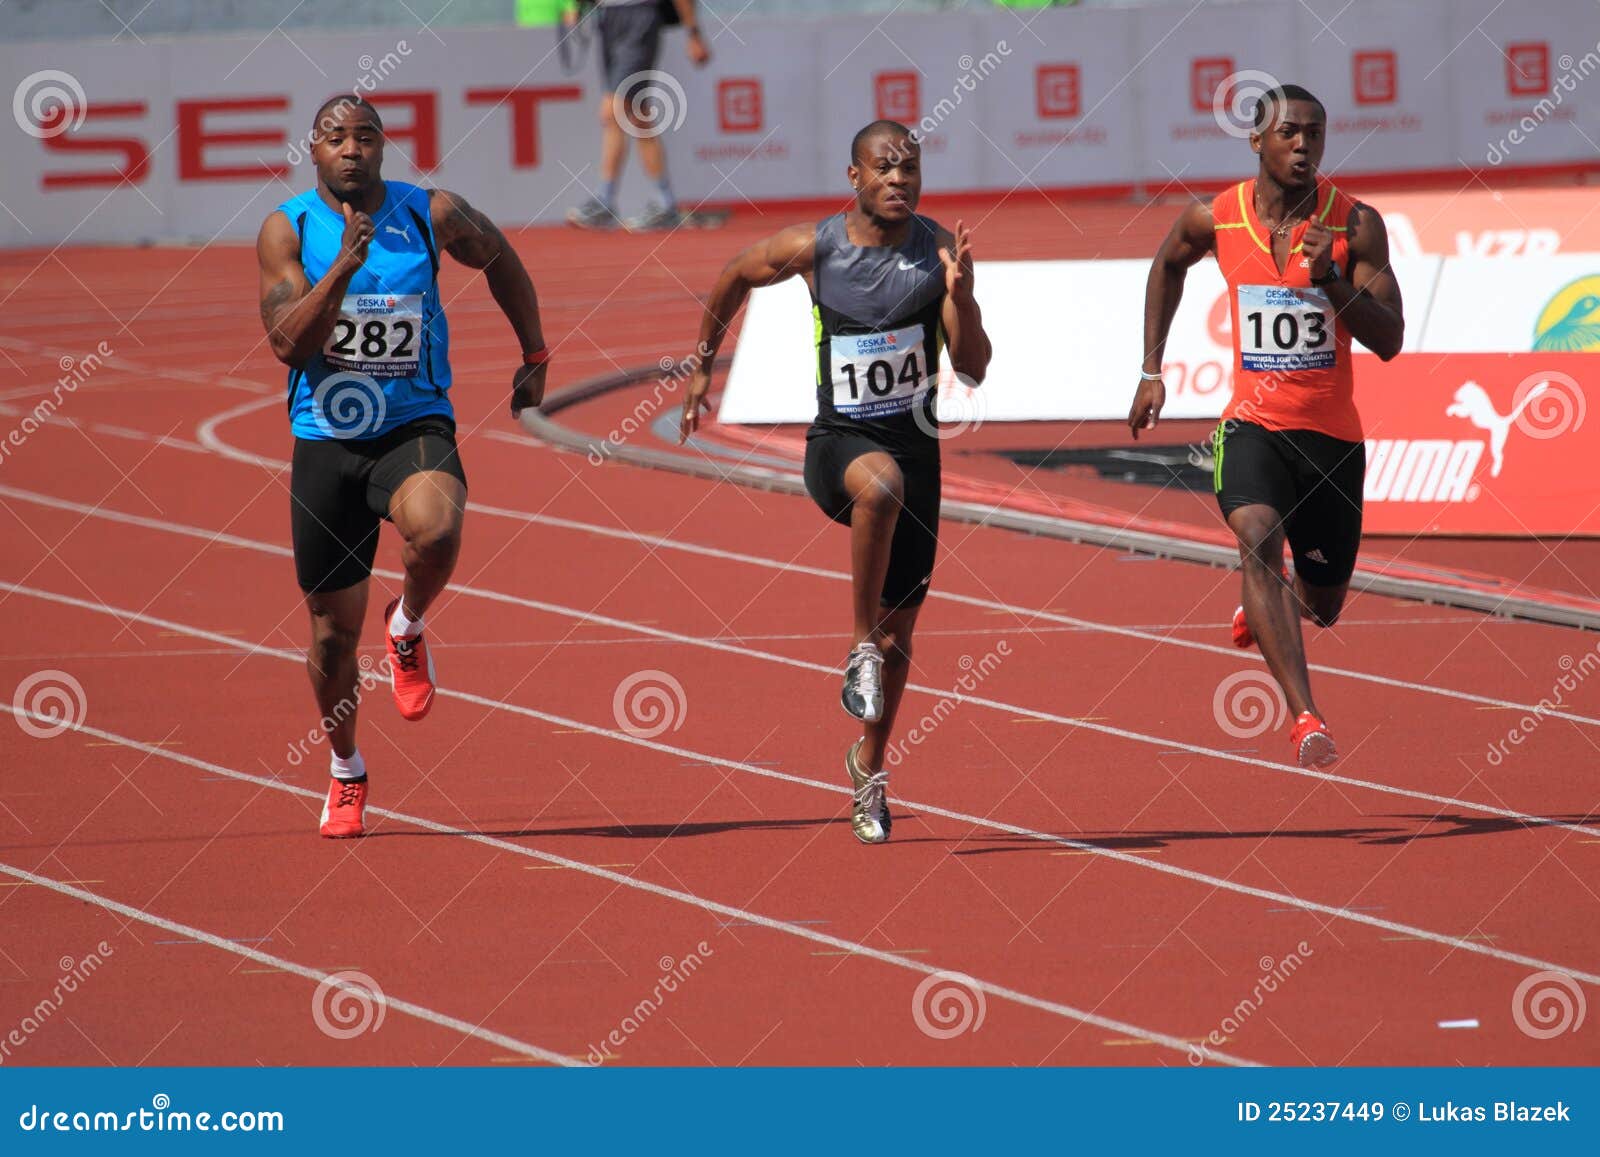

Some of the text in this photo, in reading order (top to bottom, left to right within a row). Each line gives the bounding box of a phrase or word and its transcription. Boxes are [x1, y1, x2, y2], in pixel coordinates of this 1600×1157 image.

[41, 86, 582, 191] SEAT
[330, 319, 414, 358] 282
[1247, 311, 1328, 351] 103
[840, 351, 922, 400] 104
[1364, 439, 1485, 502] UMA
